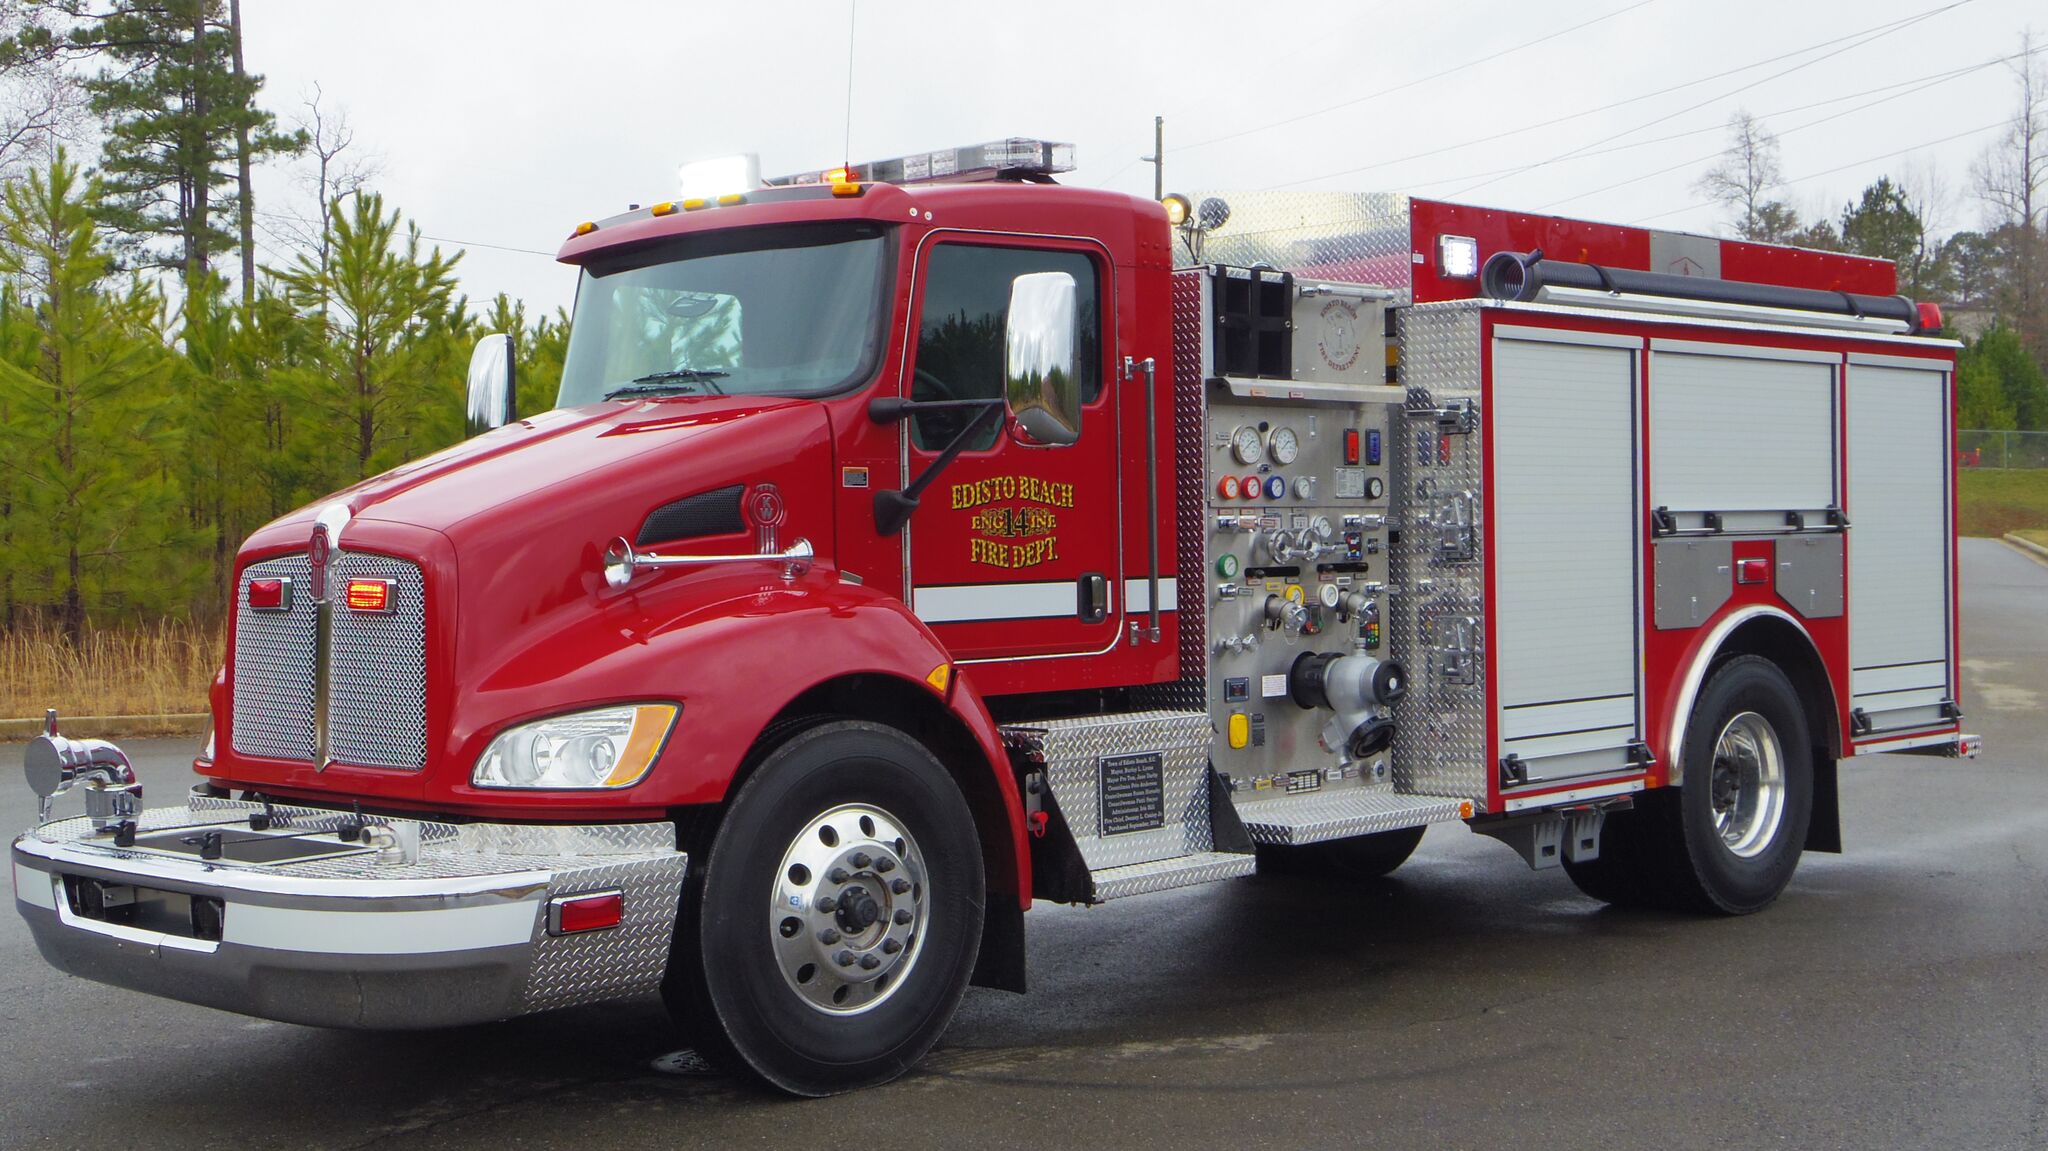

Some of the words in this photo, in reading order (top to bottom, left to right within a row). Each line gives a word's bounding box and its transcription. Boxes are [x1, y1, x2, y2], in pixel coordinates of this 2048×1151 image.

[951, 476, 1016, 510] EDISTO
[1018, 475, 1075, 508] BEACH
[1003, 506, 1030, 537] 14
[970, 538, 1010, 568] FIRE
